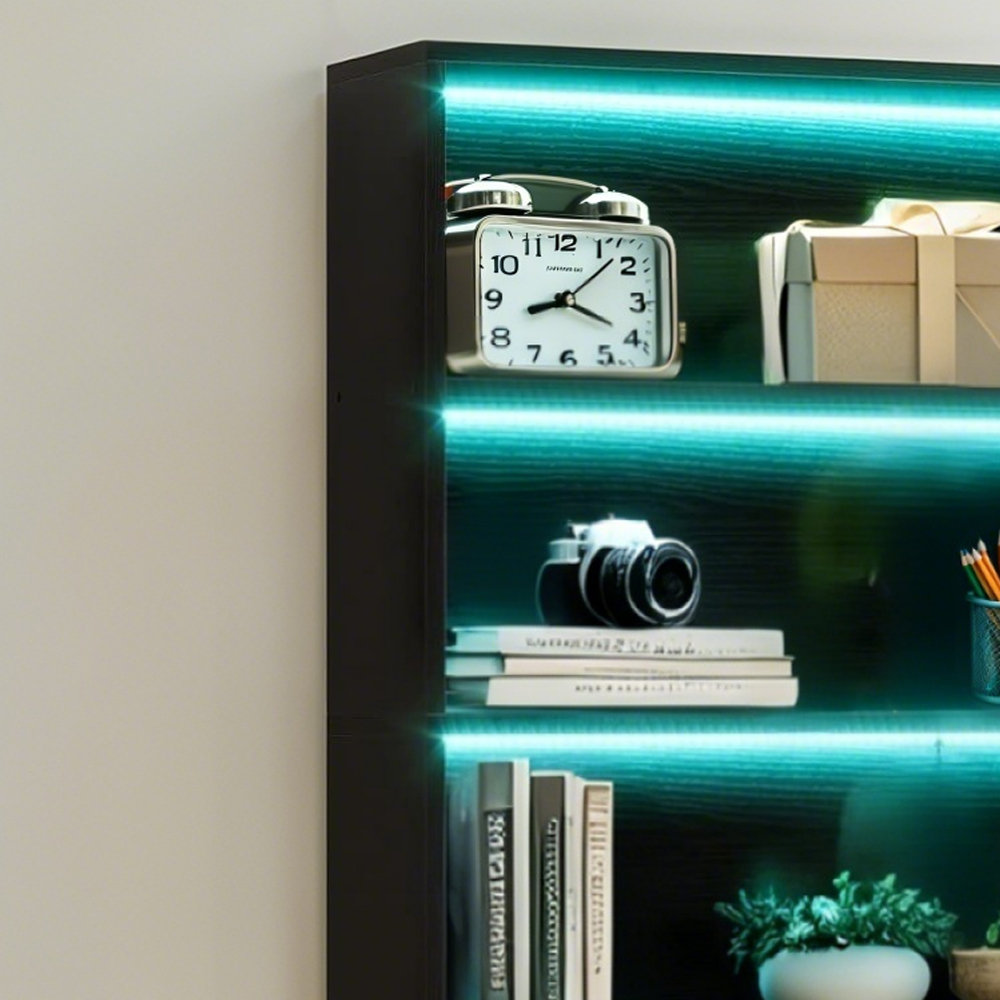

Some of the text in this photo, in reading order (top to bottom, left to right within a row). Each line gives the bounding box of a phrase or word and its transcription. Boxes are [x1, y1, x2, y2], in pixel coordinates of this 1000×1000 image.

[522, 233, 542, 257] 11
[553, 234, 577, 252] 12
[491, 255, 519, 275] 10
[620, 256, 636, 276] 2
[484, 289, 503, 310] 9
[629, 292, 646, 313] 3
[490, 327, 511, 348] 8
[623, 329, 641, 347] 4
[527, 345, 541, 363] 7
[559, 350, 577, 367] 6
[598, 345, 614, 366] 5
